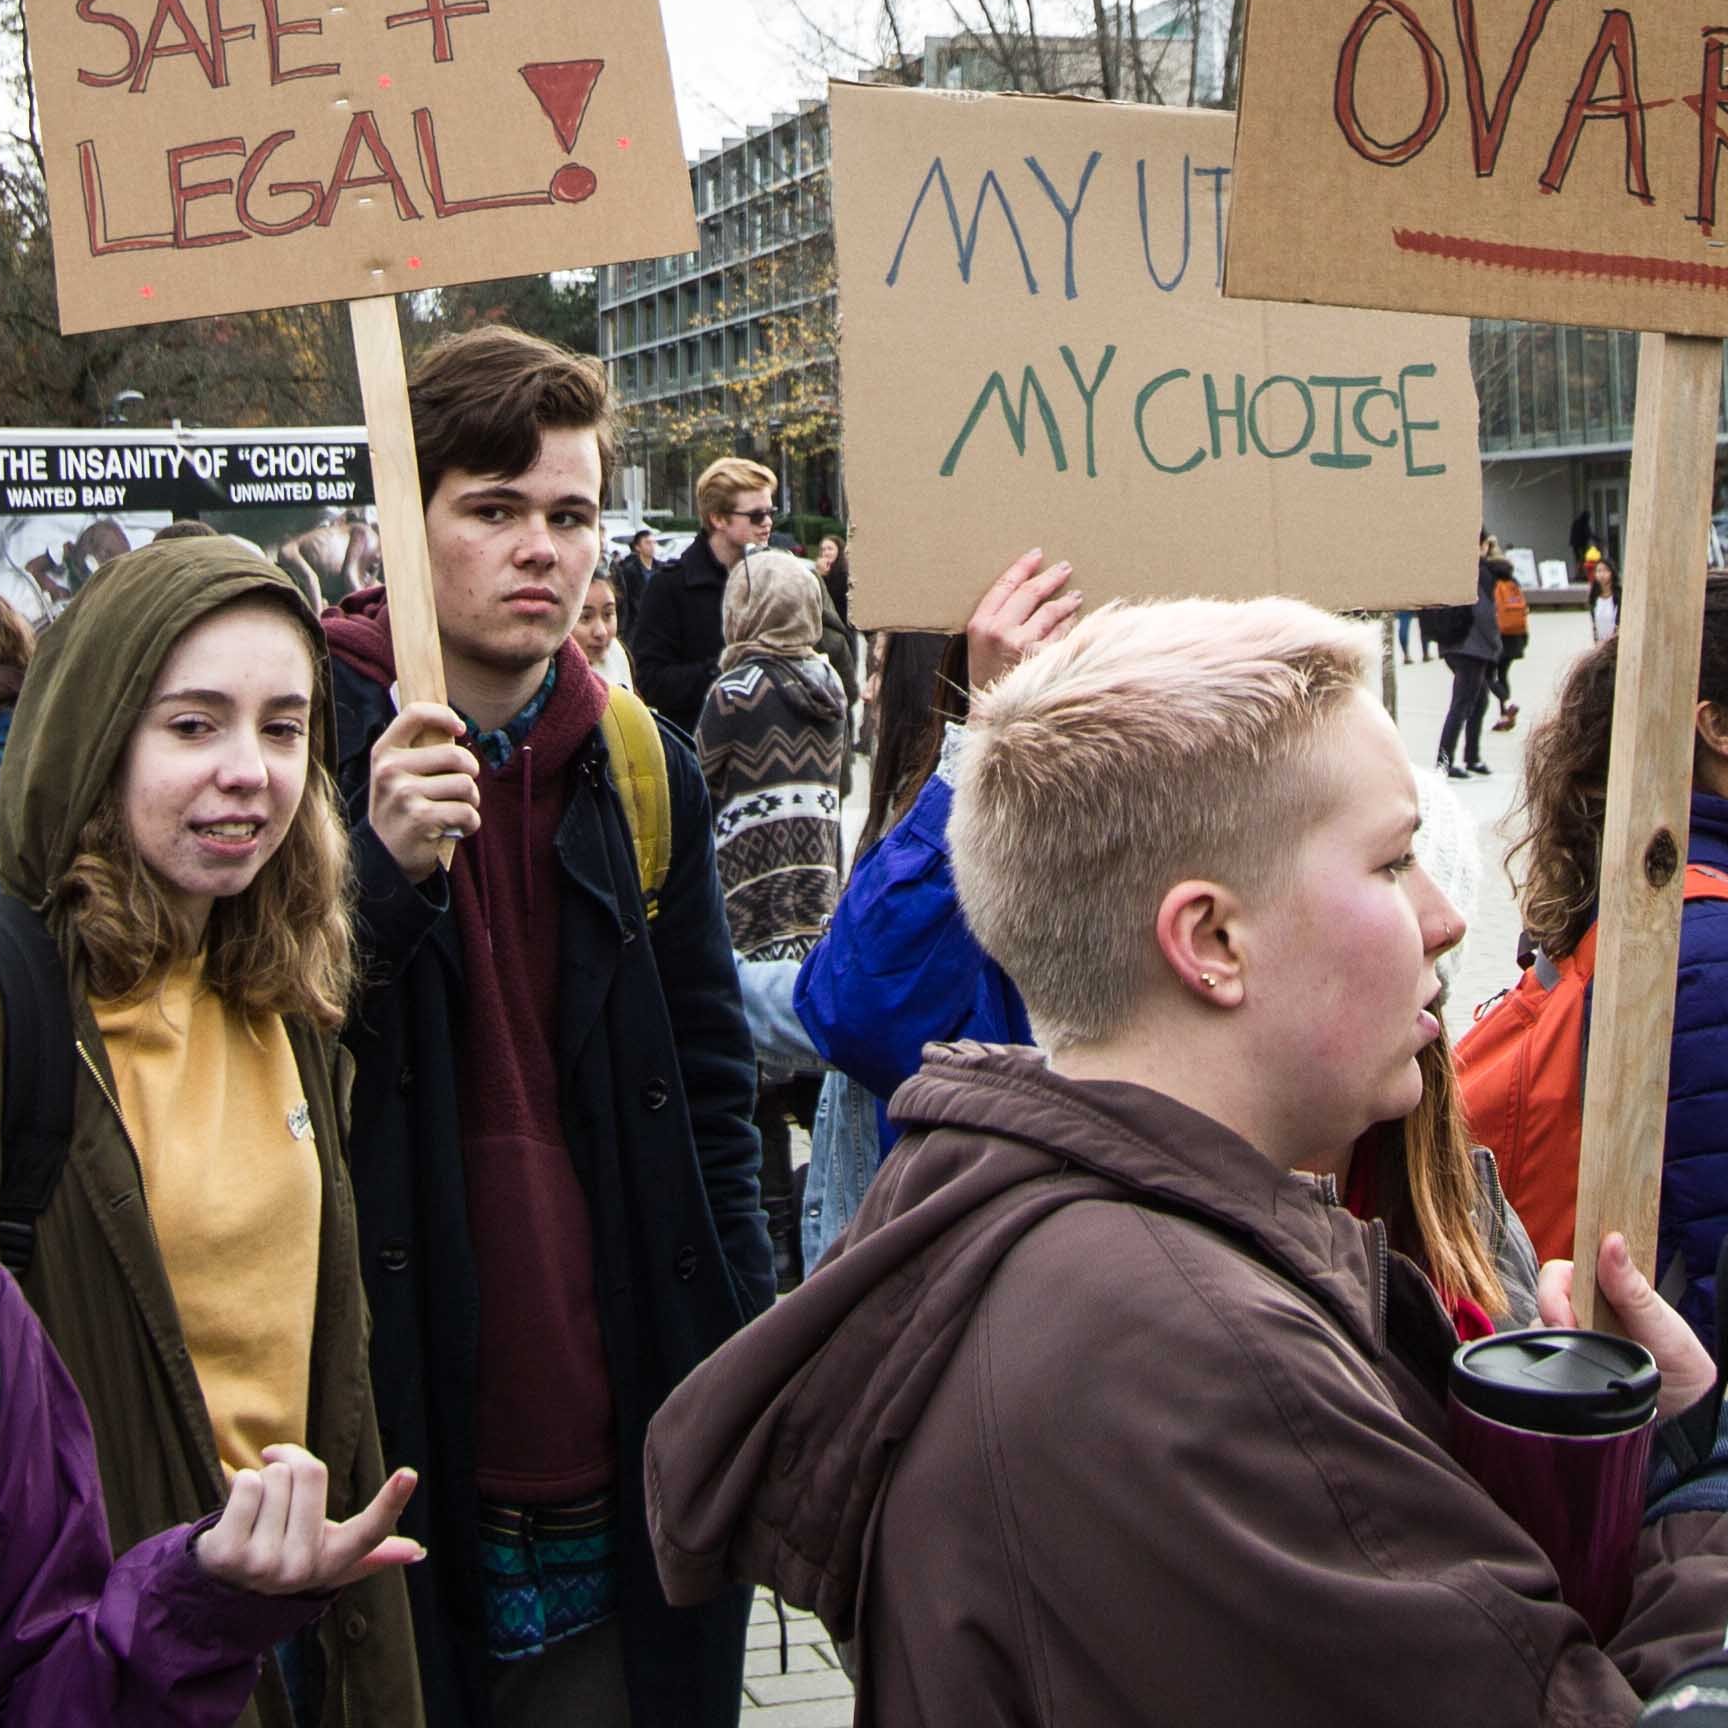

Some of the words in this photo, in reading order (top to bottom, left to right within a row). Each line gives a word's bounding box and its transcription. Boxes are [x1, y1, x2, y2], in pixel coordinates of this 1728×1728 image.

[886, 151, 1102, 300] MY
[939, 344, 1117, 478] MY
[1133, 363, 1447, 478] CHOICE
[59, 447, 186, 480] INSANITY
[192, 447, 228, 479] OF
[6, 487, 76, 508] WANTED
[82, 486, 127, 508] BABY
[229, 483, 313, 504] UNWANTED
[317, 481, 357, 501] BABY
